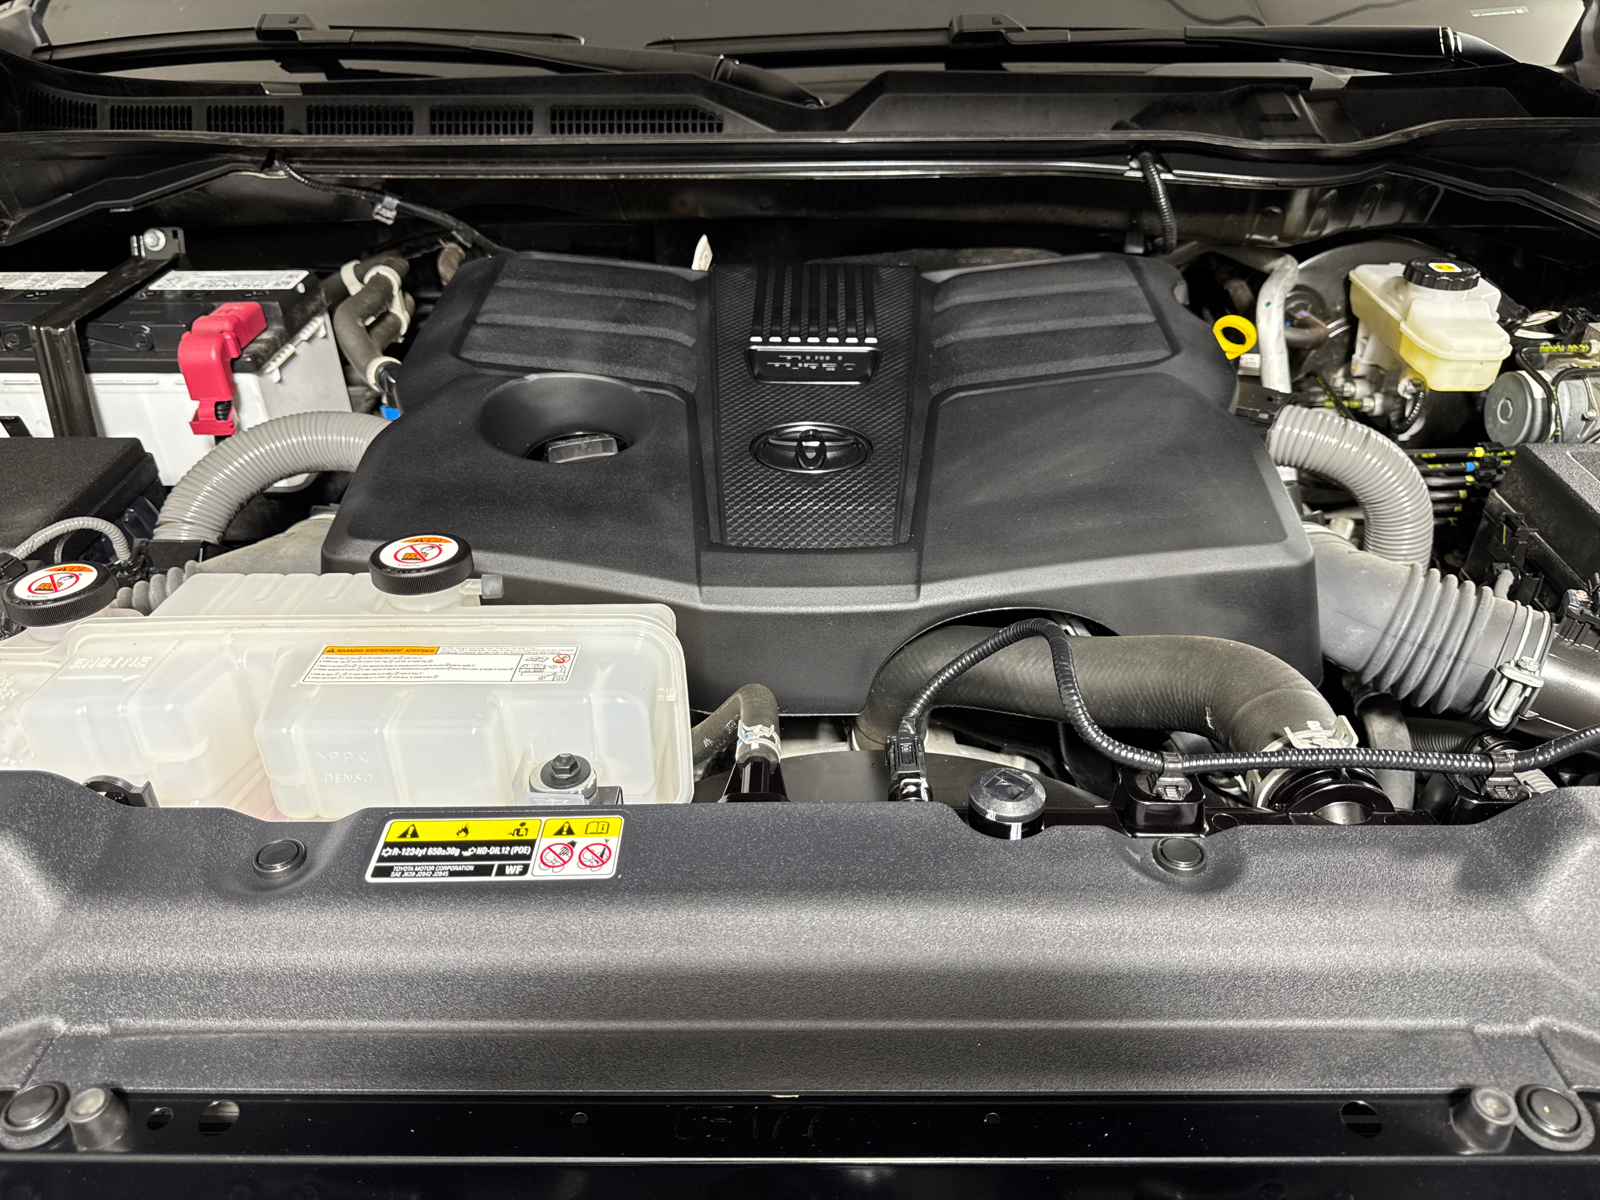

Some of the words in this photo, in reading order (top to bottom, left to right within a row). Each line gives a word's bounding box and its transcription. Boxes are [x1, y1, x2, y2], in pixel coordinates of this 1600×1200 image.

[67, 655, 154, 671] ENGINE
[324, 773, 373, 783] DENSO
[510, 845, 532, 856] (POE)
[505, 864, 524, 875] WF
